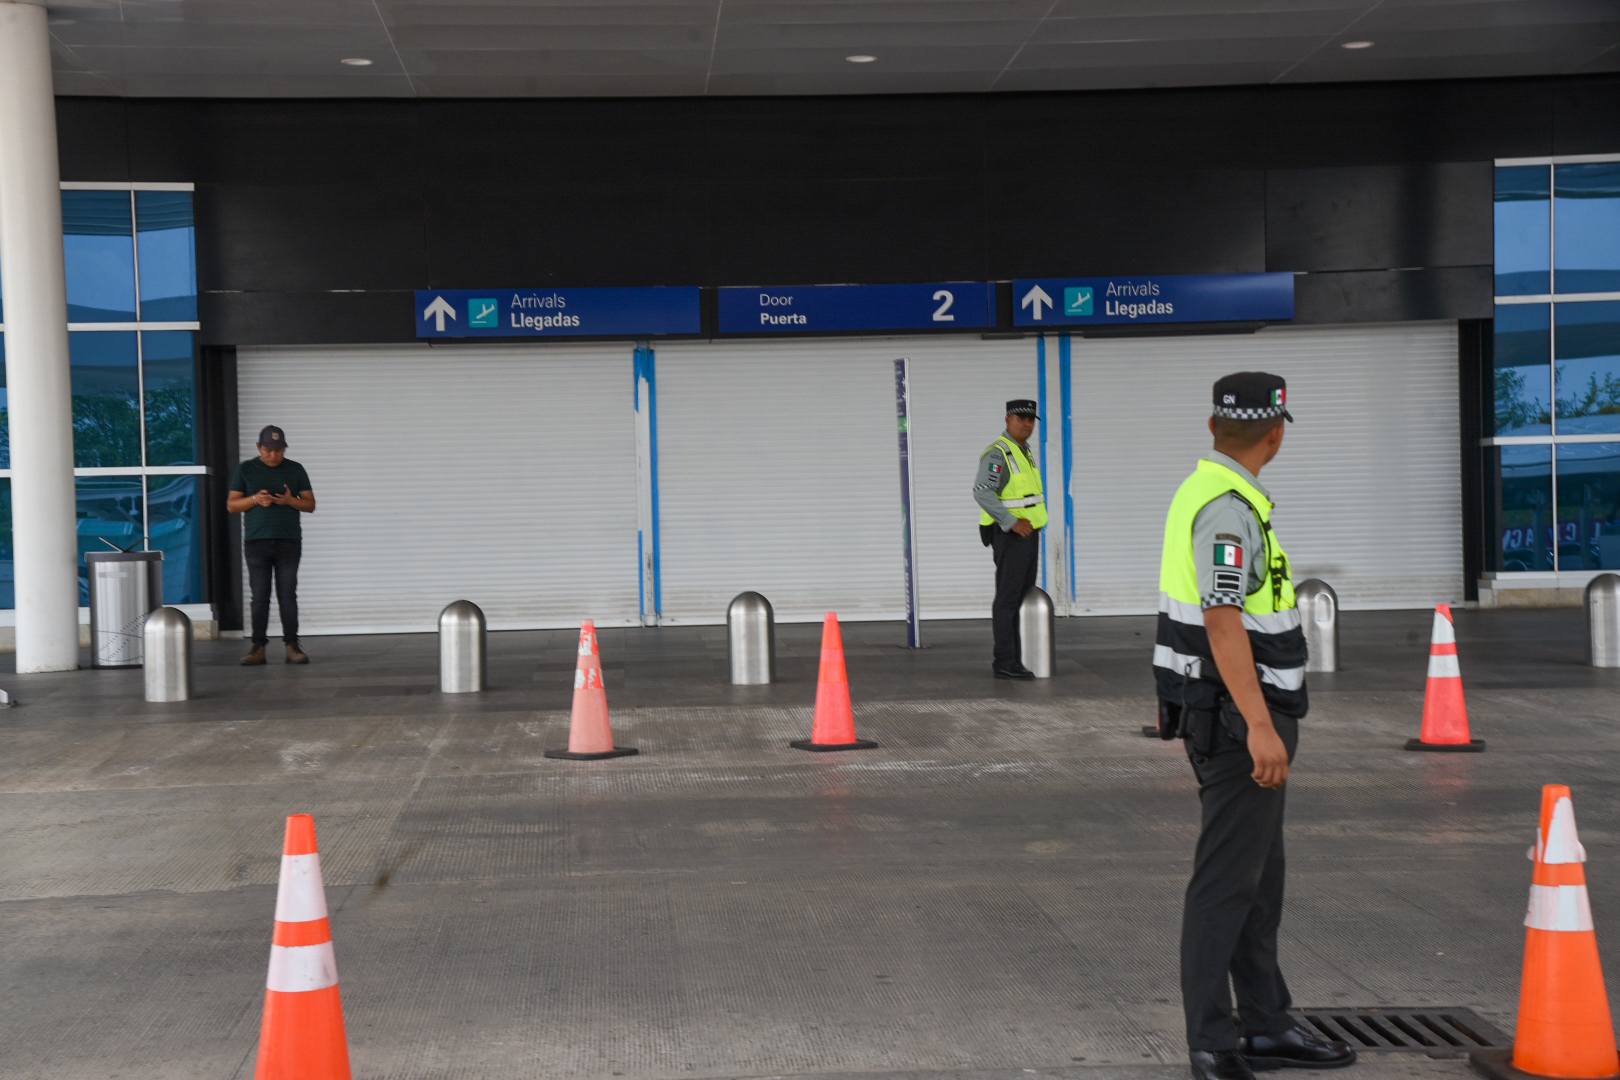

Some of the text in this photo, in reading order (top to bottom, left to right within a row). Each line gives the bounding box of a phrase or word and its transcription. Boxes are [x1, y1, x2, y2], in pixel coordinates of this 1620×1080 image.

[1106, 281, 1160, 297] Arrivals
[510, 293, 566, 309] Arrivals
[759, 293, 794, 306] Door
[932, 290, 955, 321] 2
[1105, 300, 1174, 318] Llegadas
[510, 312, 580, 331] Llegadas
[760, 312, 807, 325] Puerta
